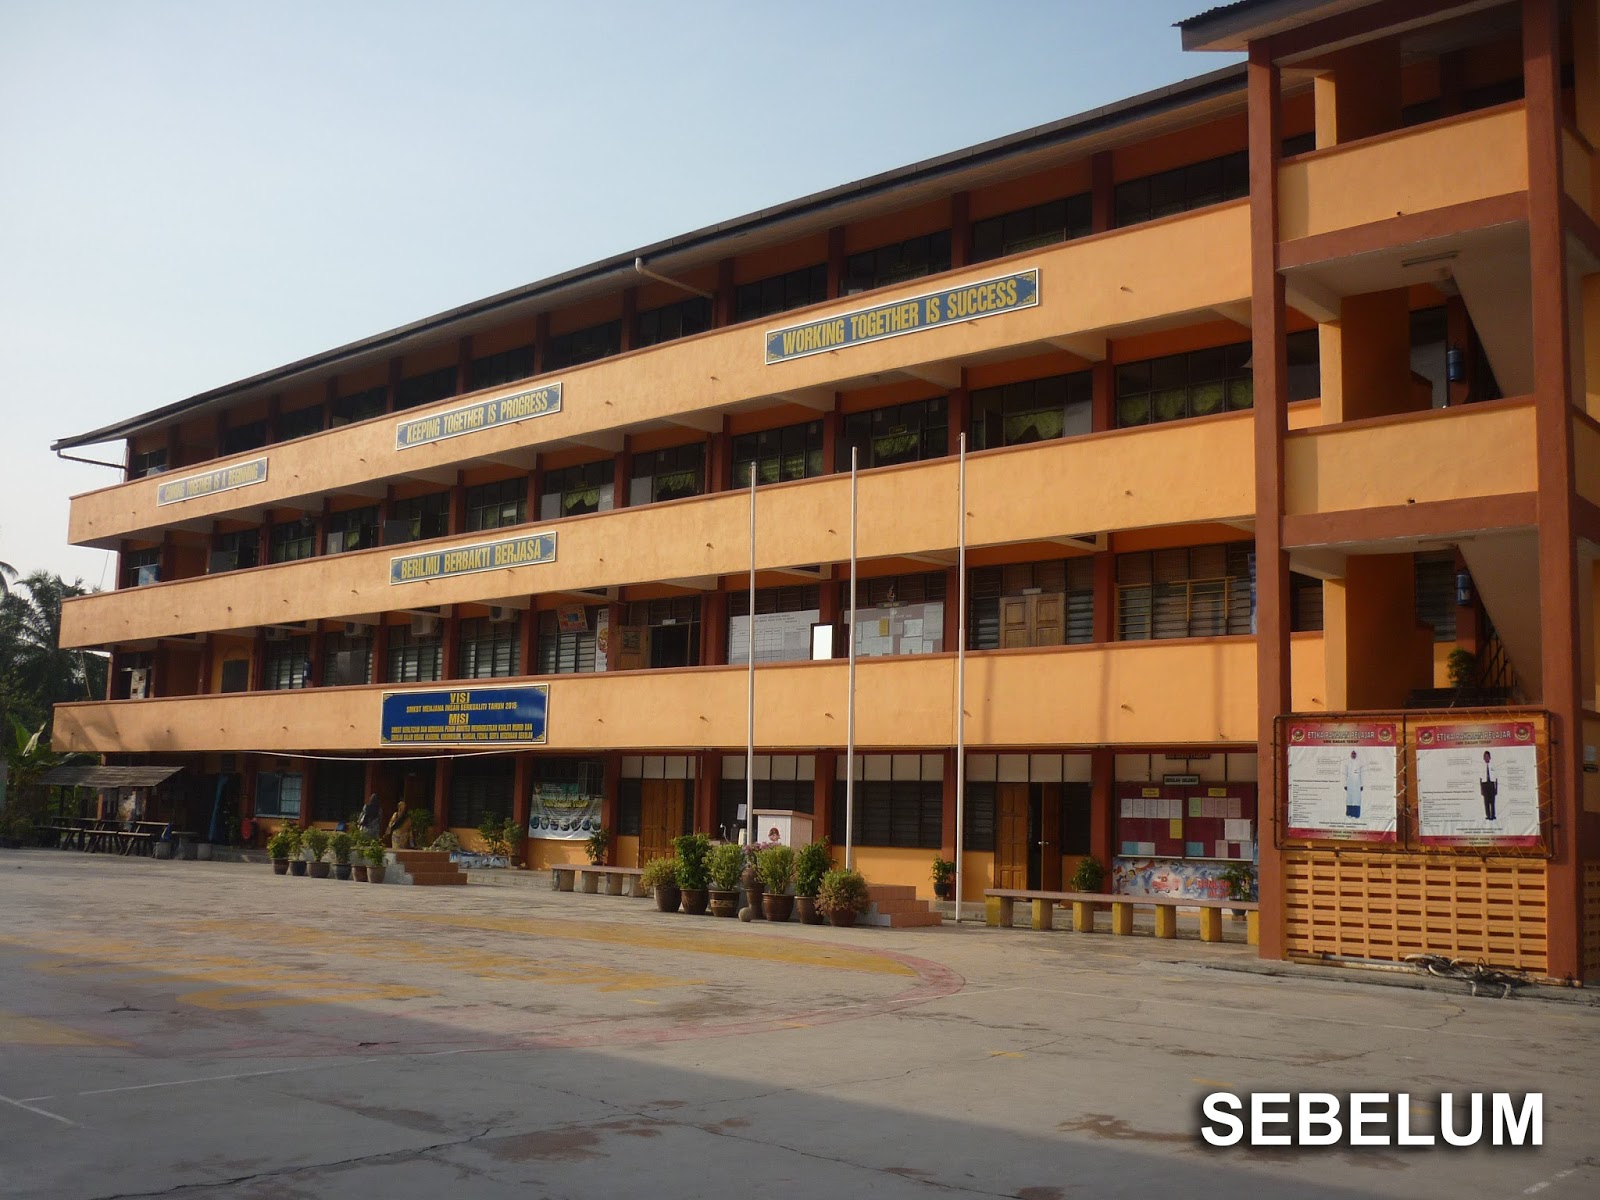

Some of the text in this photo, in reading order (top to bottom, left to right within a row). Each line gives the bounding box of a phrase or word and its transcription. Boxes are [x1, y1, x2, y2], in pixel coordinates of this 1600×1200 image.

[782, 279, 1018, 355] WORKING TOGETHER IS SUCCESS
[406, 391, 548, 443] KEEPING TOGETHER IS PROGRESS
[401, 538, 541, 579] BERILMU BERBAKTI BERJASA
[450, 692, 470, 704] VISI
[448, 713, 469, 725] MISI
[1307, 731, 1324, 739] ETIKA
[1351, 731, 1375, 739] PELAJAR
[1436, 733, 1455, 741] ETIKA
[1483, 730, 1511, 739] PELAJAR
